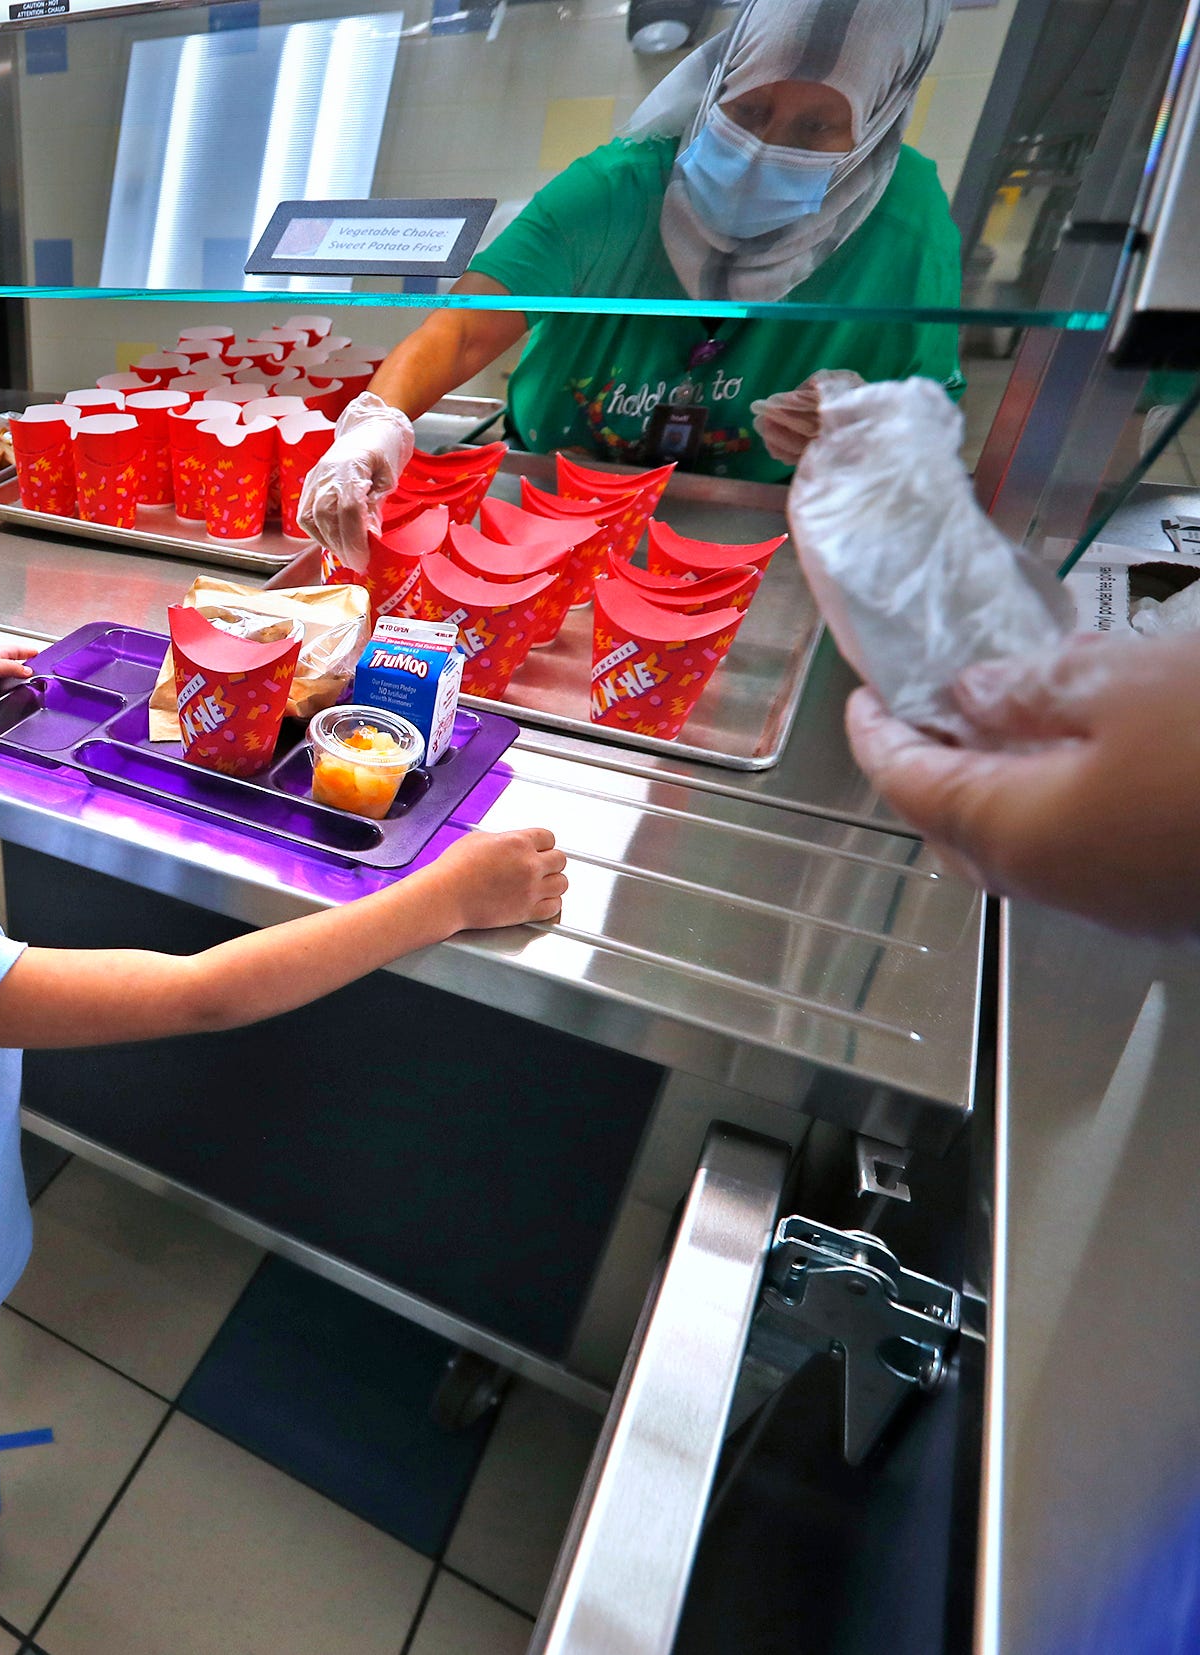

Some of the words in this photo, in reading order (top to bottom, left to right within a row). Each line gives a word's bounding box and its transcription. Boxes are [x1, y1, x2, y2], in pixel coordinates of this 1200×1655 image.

[17, 8, 45, 18] ATTENTION
[48, 5, 66, 14] CHAUD
[23, 1, 45, 10] CAUTION
[339, 227, 400, 237] Vegetable
[402, 228, 449, 237] Choice:
[328, 240, 366, 249] Sweet
[367, 241, 410, 251] Potato
[412, 242, 444, 252] Fries
[606, 381, 666, 417] hold
[711, 369, 743, 401] to
[1095, 582, 1113, 592] free
[1094, 592, 1116, 616] powder
[393, 625, 409, 633] OPEN
[1093, 616, 1116, 632] vinyl
[368, 648, 429, 679] TruMoo
[378, 686, 388, 695] NO
